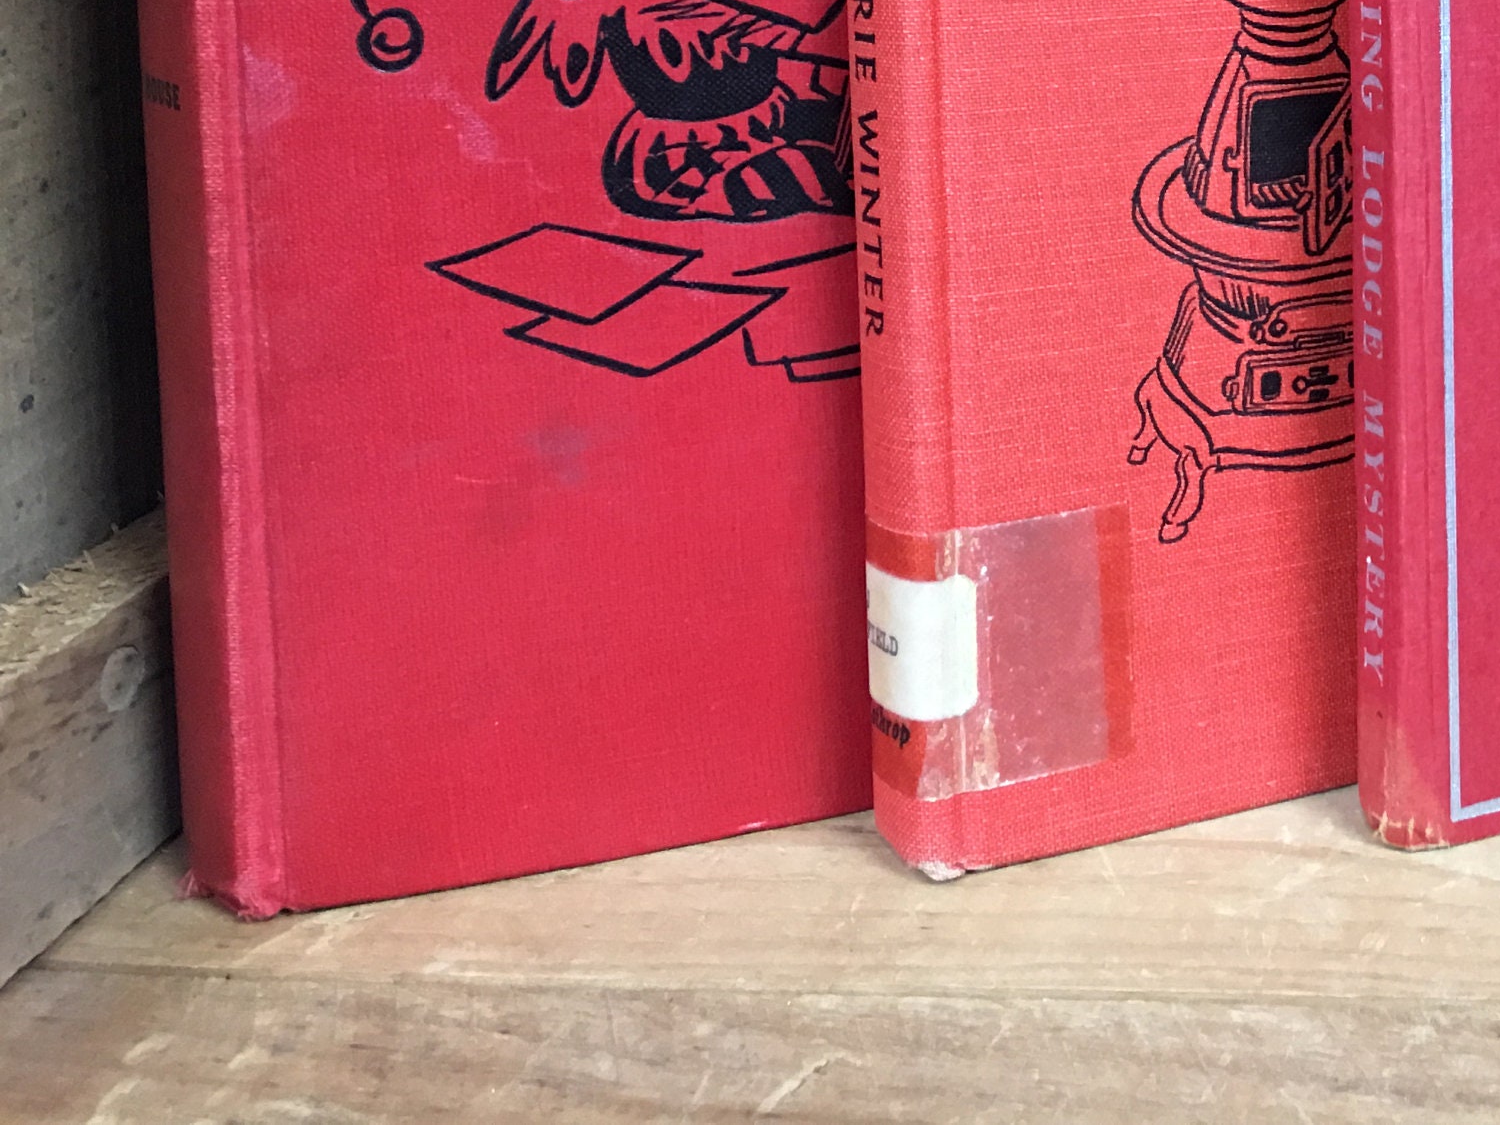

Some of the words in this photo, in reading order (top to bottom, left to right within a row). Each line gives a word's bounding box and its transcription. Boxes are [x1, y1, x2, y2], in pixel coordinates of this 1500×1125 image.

[857, 109, 885, 338] WINTER
[1362, 146, 1385, 360] LODGE
[1363, 391, 1386, 688] MYSTERY
